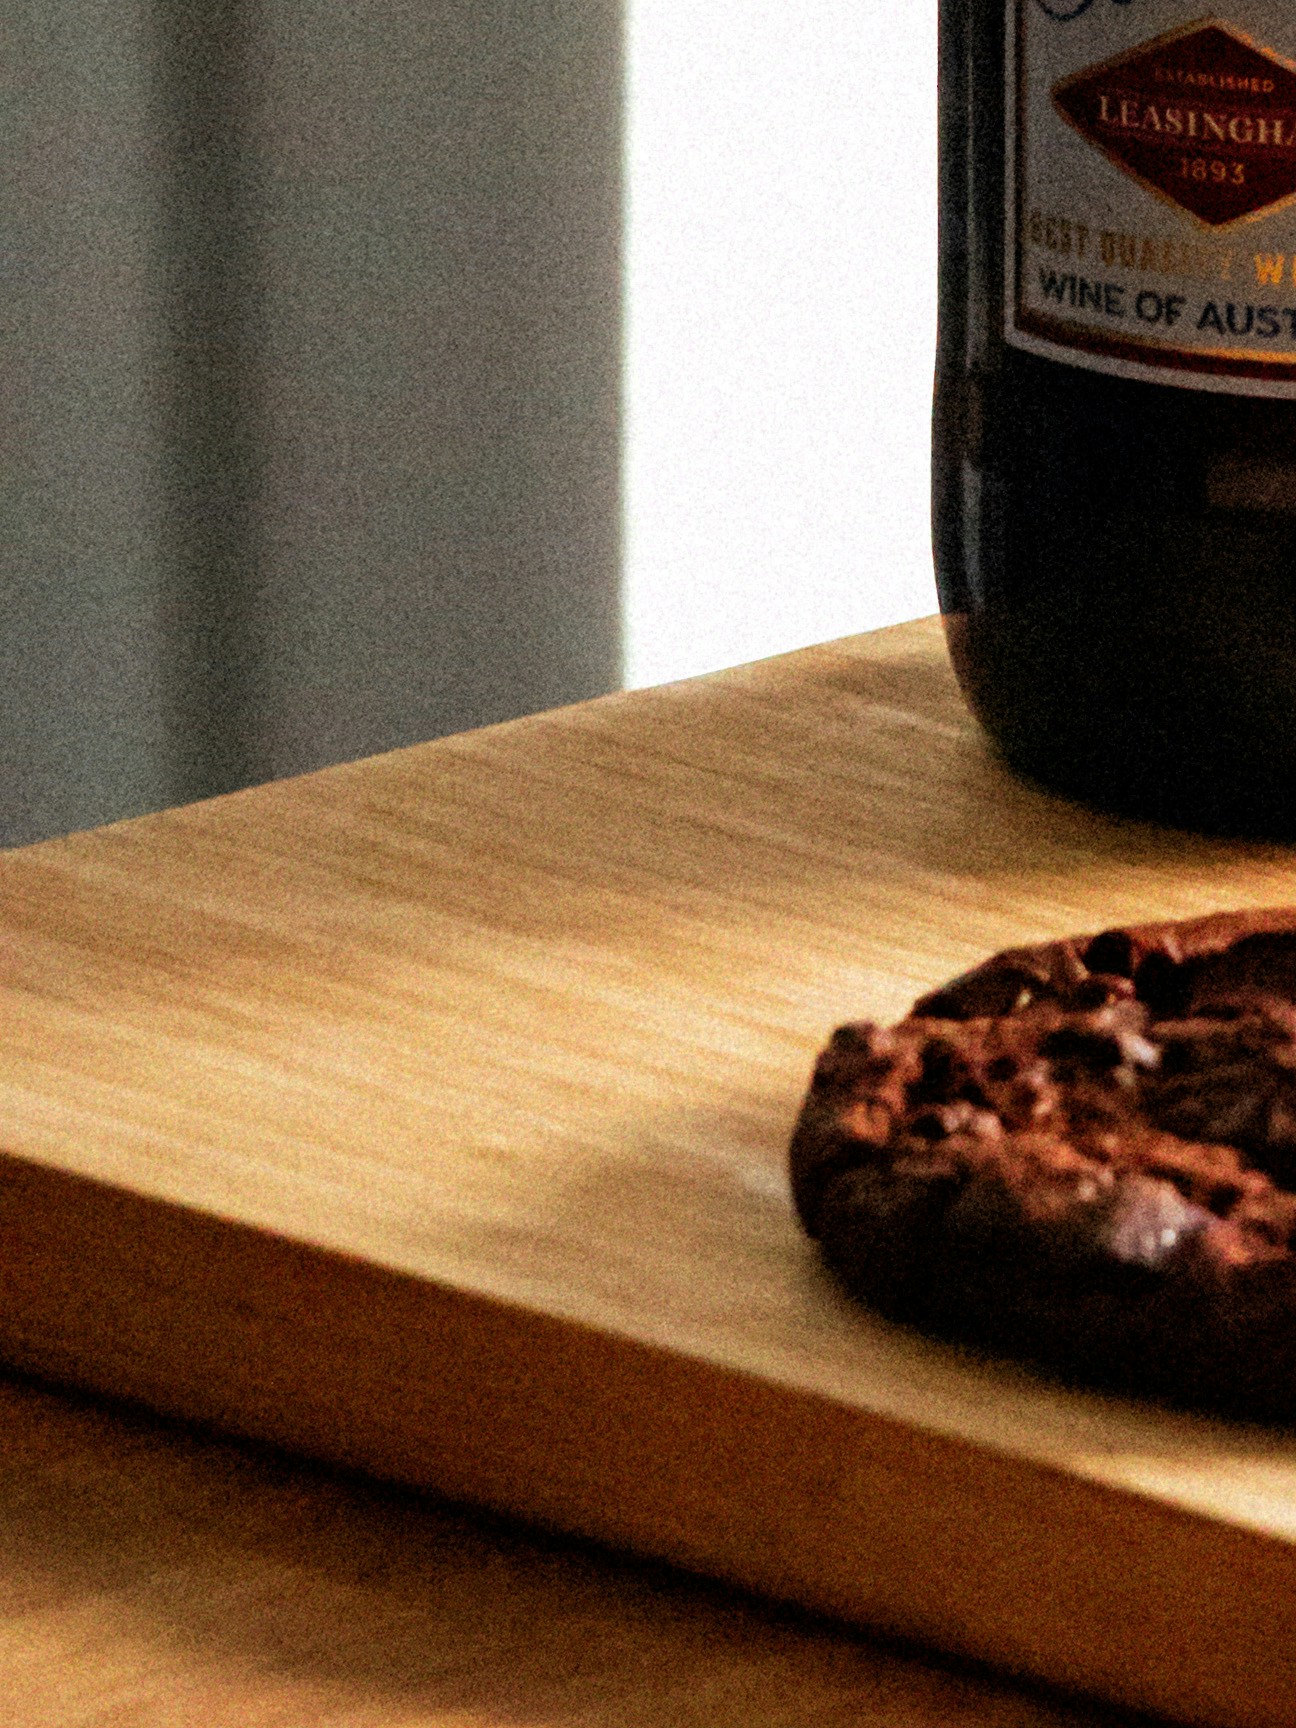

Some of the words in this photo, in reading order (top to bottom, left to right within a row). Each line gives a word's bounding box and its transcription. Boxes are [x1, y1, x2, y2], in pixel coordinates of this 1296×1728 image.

[1179, 157, 1246, 185] 1893
[1038, 267, 1126, 318] WINE
[1134, 290, 1187, 326] OF
